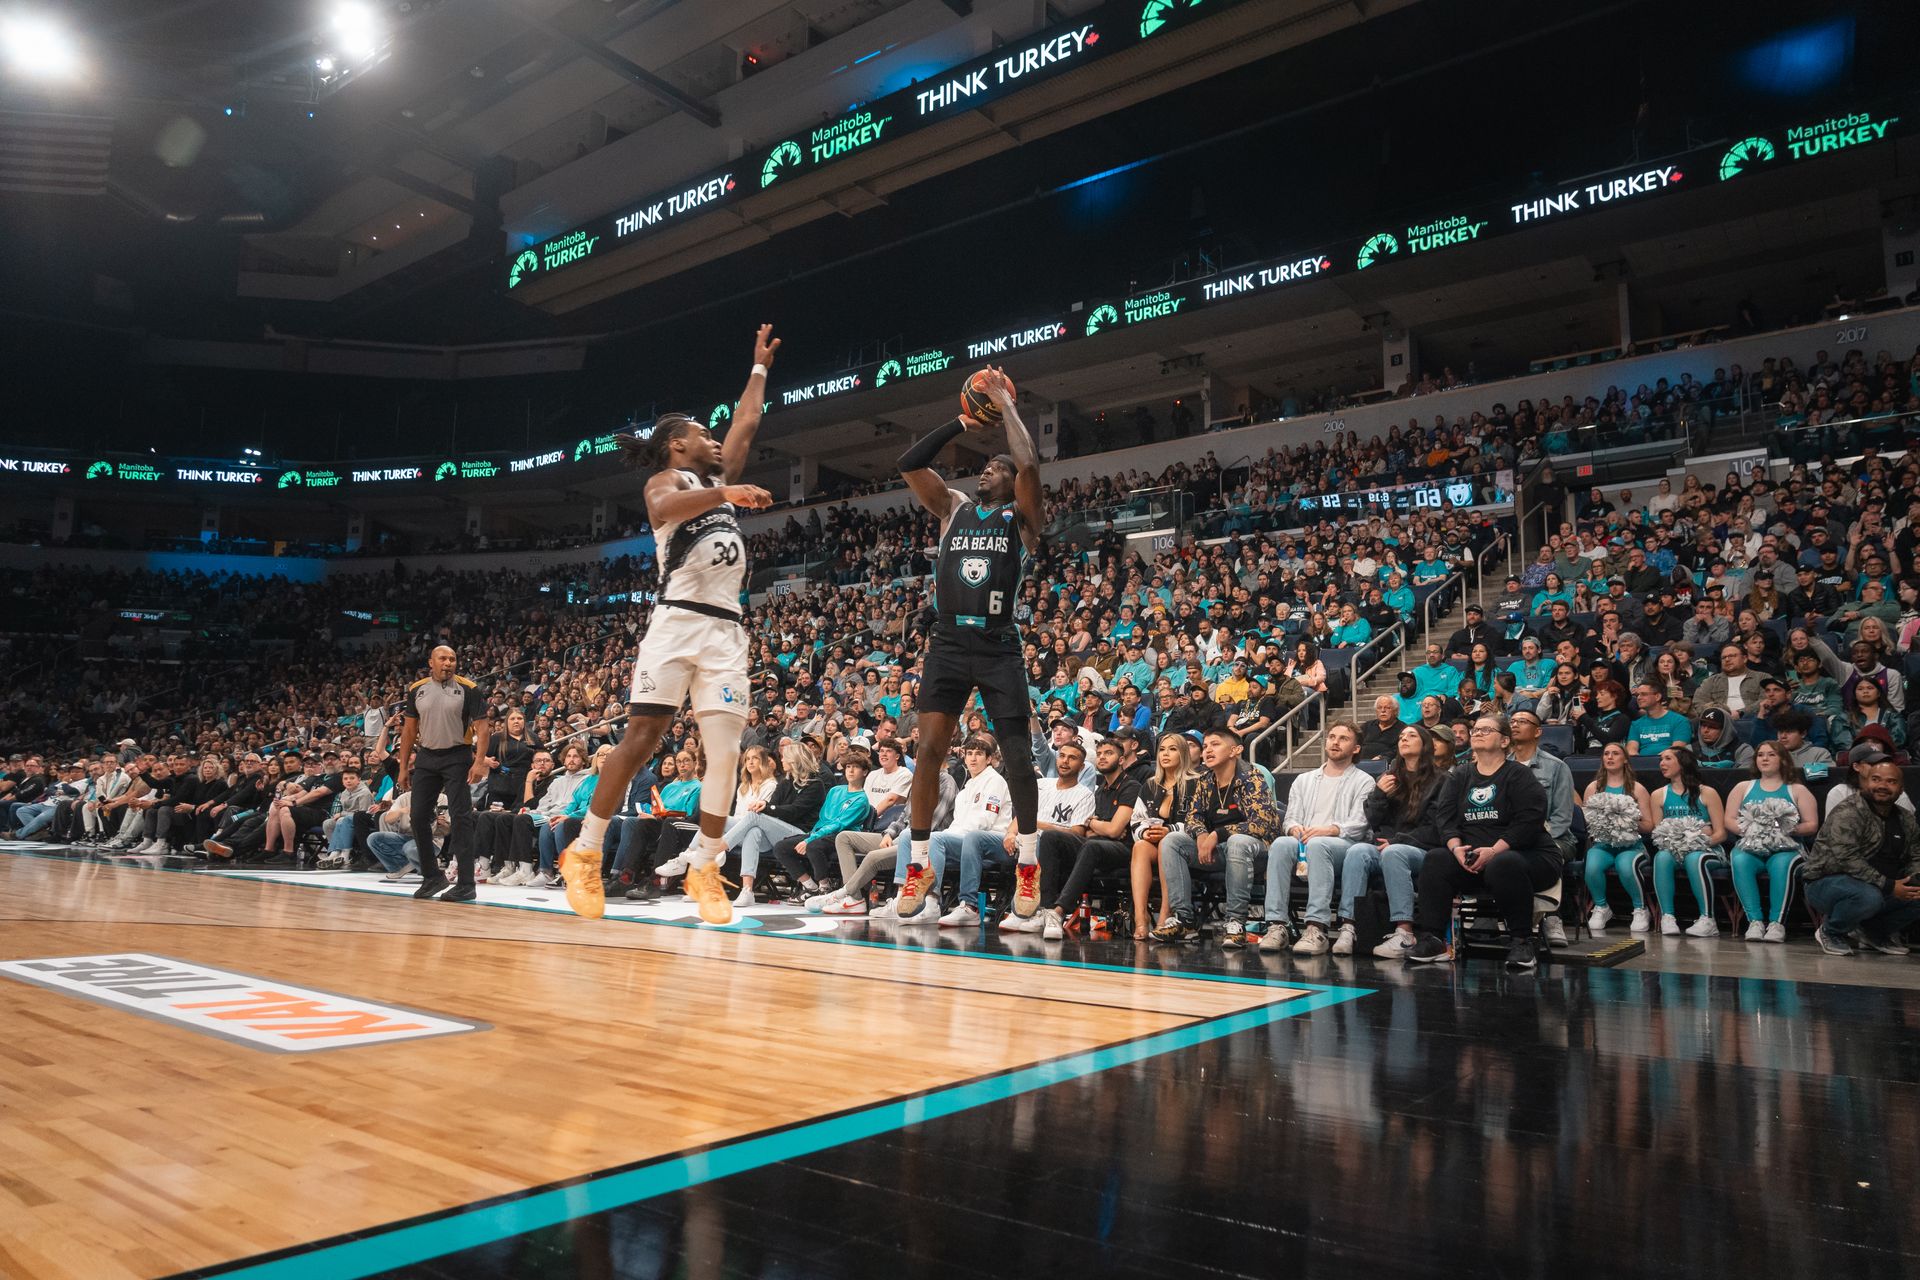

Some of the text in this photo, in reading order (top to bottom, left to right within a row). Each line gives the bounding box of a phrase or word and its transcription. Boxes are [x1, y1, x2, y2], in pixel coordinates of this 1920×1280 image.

[916, 25, 1087, 115] THINK TURKEY
[812, 111, 871, 142] Manitoba
[1787, 113, 1869, 142] Manitoba
[1511, 166, 1673, 223] THINK TURKEY
[615, 175, 728, 238] THINK TURKEY
[1407, 216, 1468, 237] Manitoba
[544, 231, 586, 255] Manitoba
[1203, 258, 1320, 301] THINK TURKEY
[1125, 292, 1170, 310] Manitoba
[967, 323, 1059, 359] THINK TURKEY
[1836, 327, 1867, 344] 207
[906, 350, 943, 366] Manitoba
[782, 374, 857, 405] THINK TURKEY
[634, 426, 656, 440] THIN
[1324, 418, 1345, 433] 206
[594, 441, 619, 455] TURKE
[22, 460, 66, 474] TURKEY
[119, 463, 154, 471] Manitoba
[461, 460, 492, 469] Manitoba
[509, 450, 562, 473] THINK TURKEY
[177, 469, 257, 483] THINK TURKEY
[306, 470, 335, 478] Manitoba
[352, 468, 418, 482] THINK TURKEY
[958, 528, 1004, 536] WINNIPEG
[950, 536, 1009, 553] SEA BEARS
[1153, 536, 1175, 550] 106
[711, 541, 739, 566] 30
[776, 584, 791, 596] 105
[989, 590, 1004, 615] 6
[1051, 803, 1073, 822] NY
[1463, 810, 1499, 821] SEA BEARS
[1665, 809, 1677, 817] SEA
